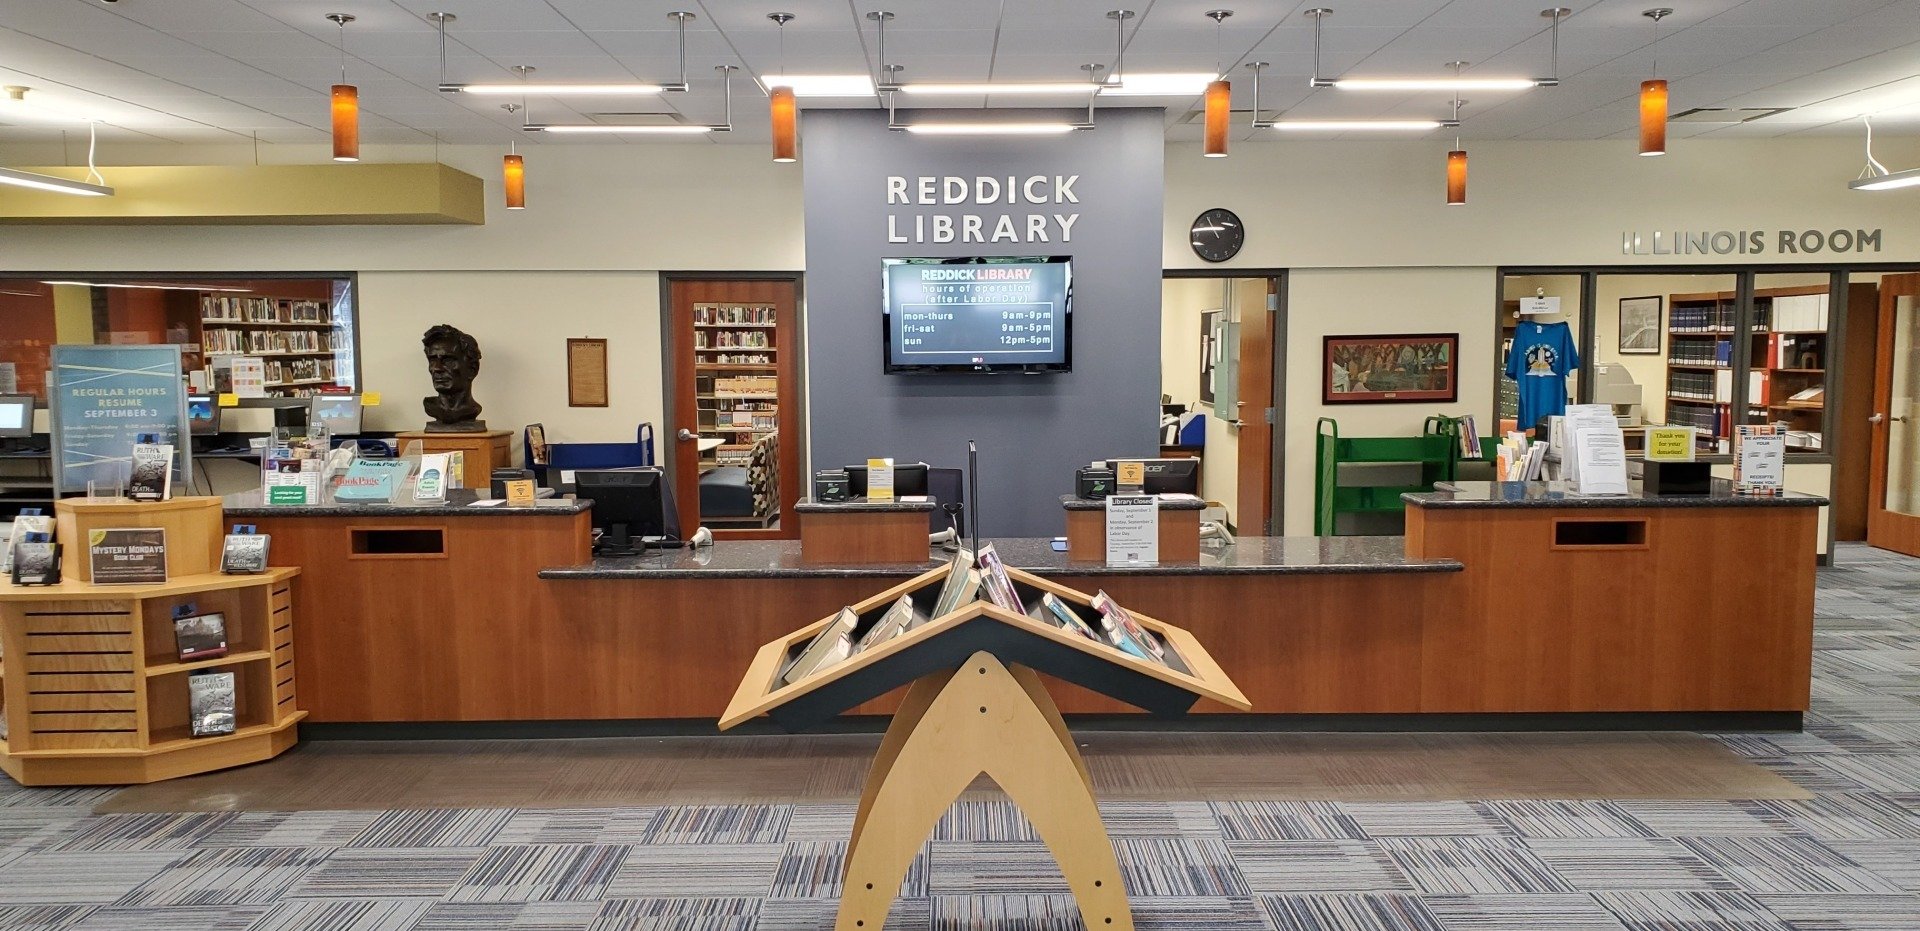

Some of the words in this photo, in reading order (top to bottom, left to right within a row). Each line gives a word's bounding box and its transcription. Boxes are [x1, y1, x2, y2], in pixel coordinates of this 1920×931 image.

[887, 175, 1080, 205] REDDICK
[888, 213, 1080, 243] LIBRARY
[1622, 230, 1765, 255] ILLINOIS
[1778, 229, 1882, 254] ROOM
[921, 269, 976, 281] REDDICK
[977, 269, 1032, 280] LIBRARY
[922, 284, 954, 293] hours
[960, 284, 970, 292] of
[975, 284, 1031, 294] operation
[925, 295, 959, 304] (after
[964, 295, 994, 303] Labor
[1002, 295, 1028, 304] Day)
[904, 312, 954, 320] mon-thurs
[1002, 311, 1051, 321] 9am-9pm
[904, 325, 935, 333] fri-sat
[1001, 324, 1051, 334] 9am-5pm
[1000, 336, 1051, 346] 12pm-5pm
[72, 388, 124, 397] REGULAR
[128, 388, 167, 396] HOURS
[98, 399, 142, 407] RESUME
[84, 409, 147, 418] SEPTEMBER
[150, 409, 158, 417] 3
[1112, 498, 1132, 506] Library
[92, 546, 128, 554] MYSTERY
[205, 682, 232, 690] WARE
